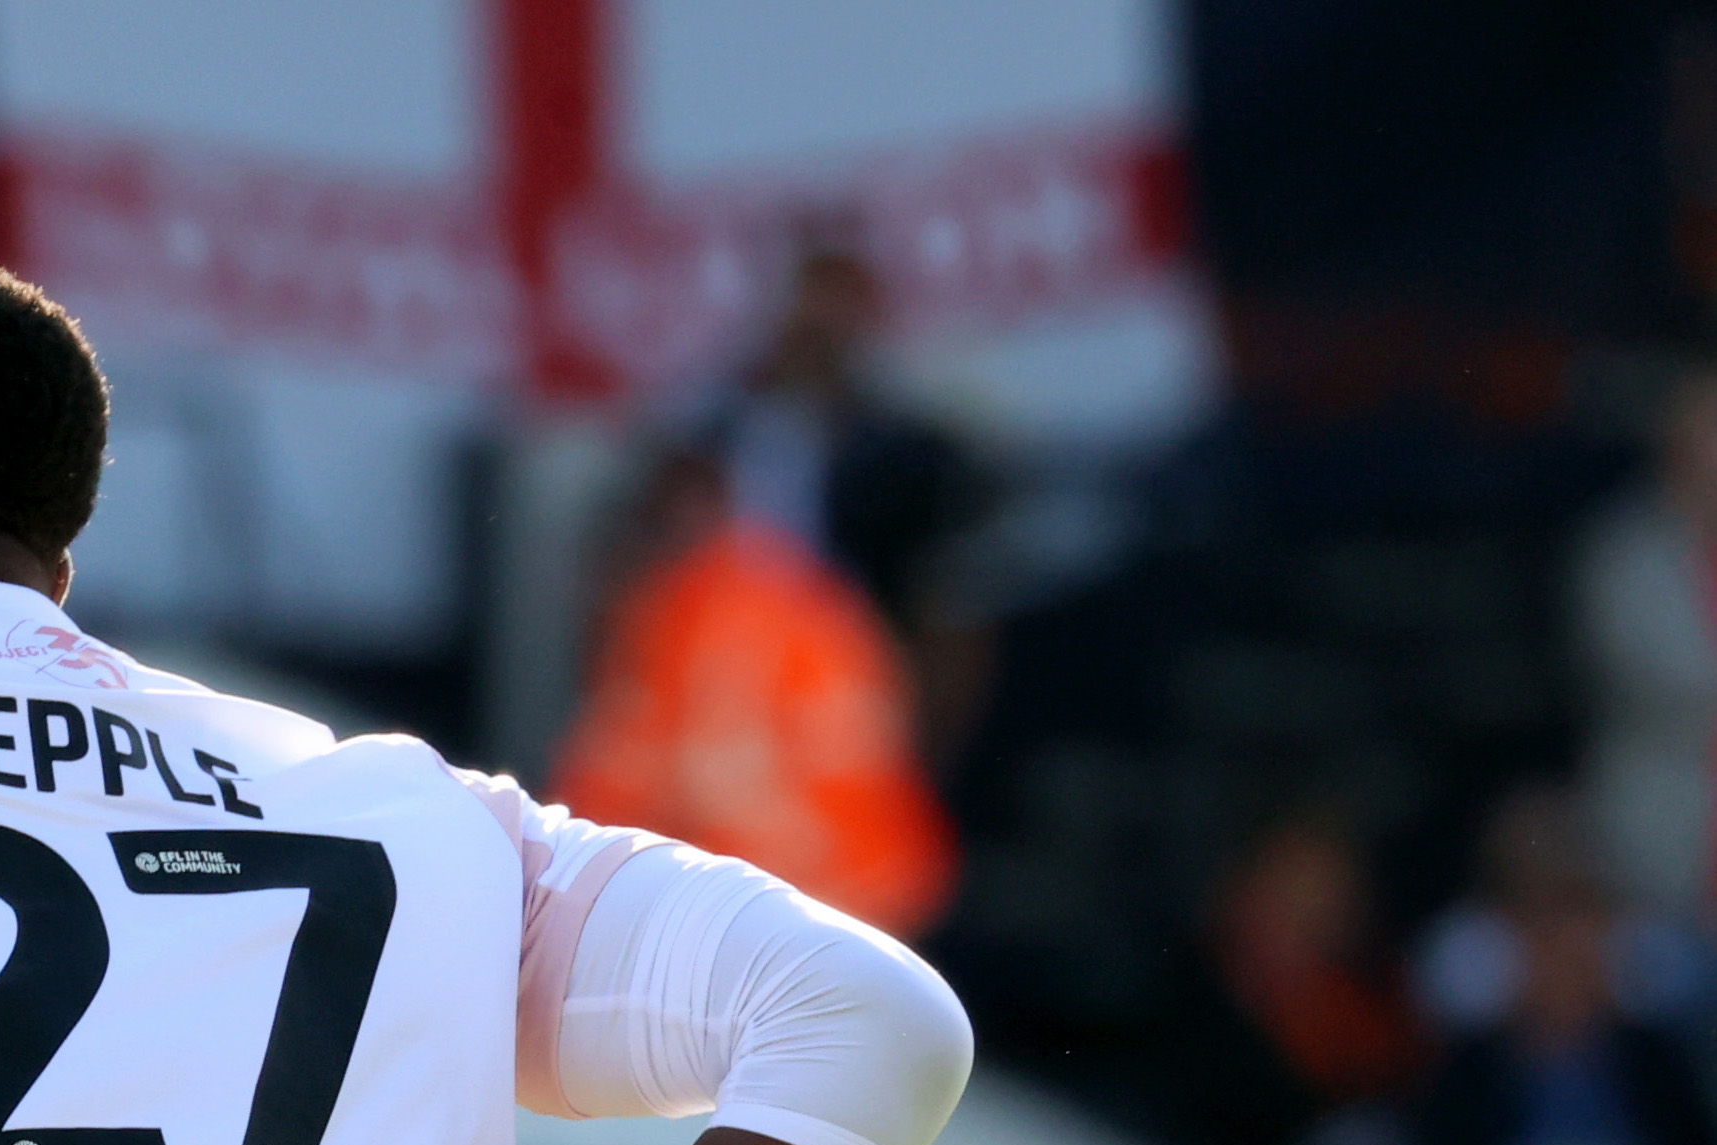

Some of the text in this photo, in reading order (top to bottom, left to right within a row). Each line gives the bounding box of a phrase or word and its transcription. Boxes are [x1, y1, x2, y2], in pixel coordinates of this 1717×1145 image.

[159, 850, 226, 863] EFL IN THE
[163, 861, 242, 875] COMMUNITY
